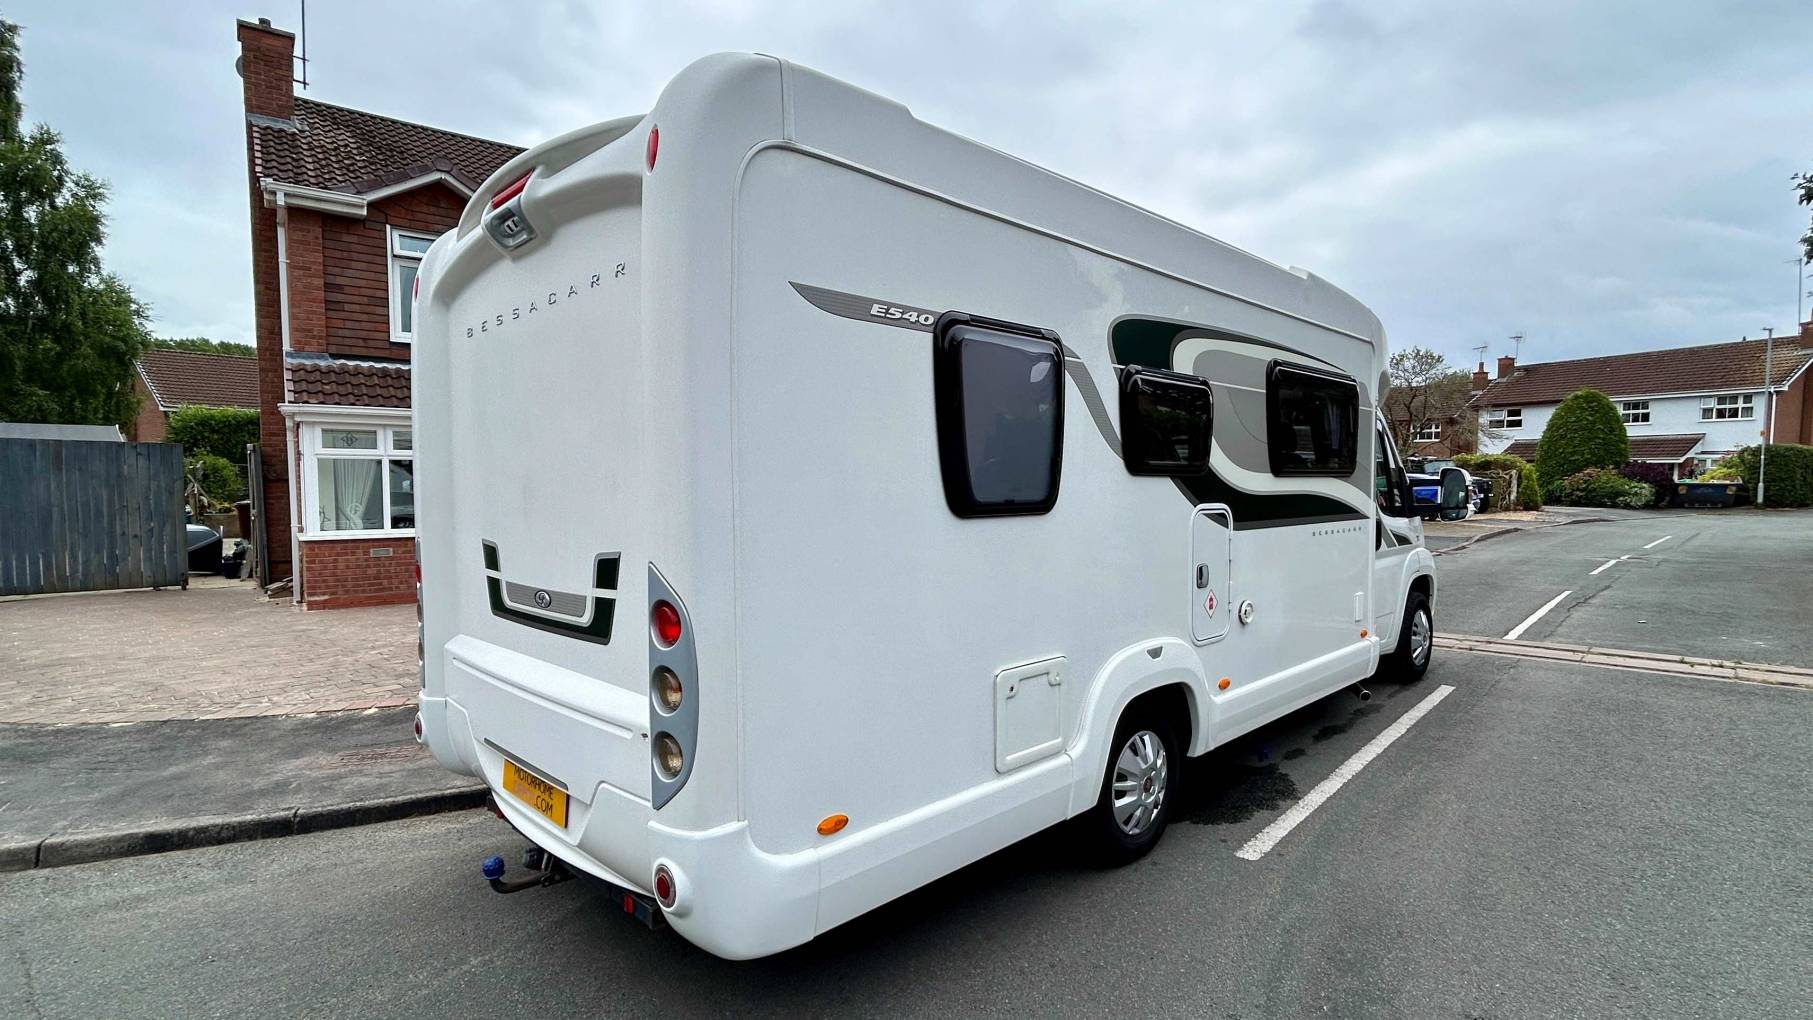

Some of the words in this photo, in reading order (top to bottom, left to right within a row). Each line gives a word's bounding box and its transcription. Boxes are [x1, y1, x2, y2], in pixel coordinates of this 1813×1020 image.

[466, 262, 626, 338] BESSACARR
[870, 303, 934, 325] E540
[513, 764, 554, 801] MOTORHOME
